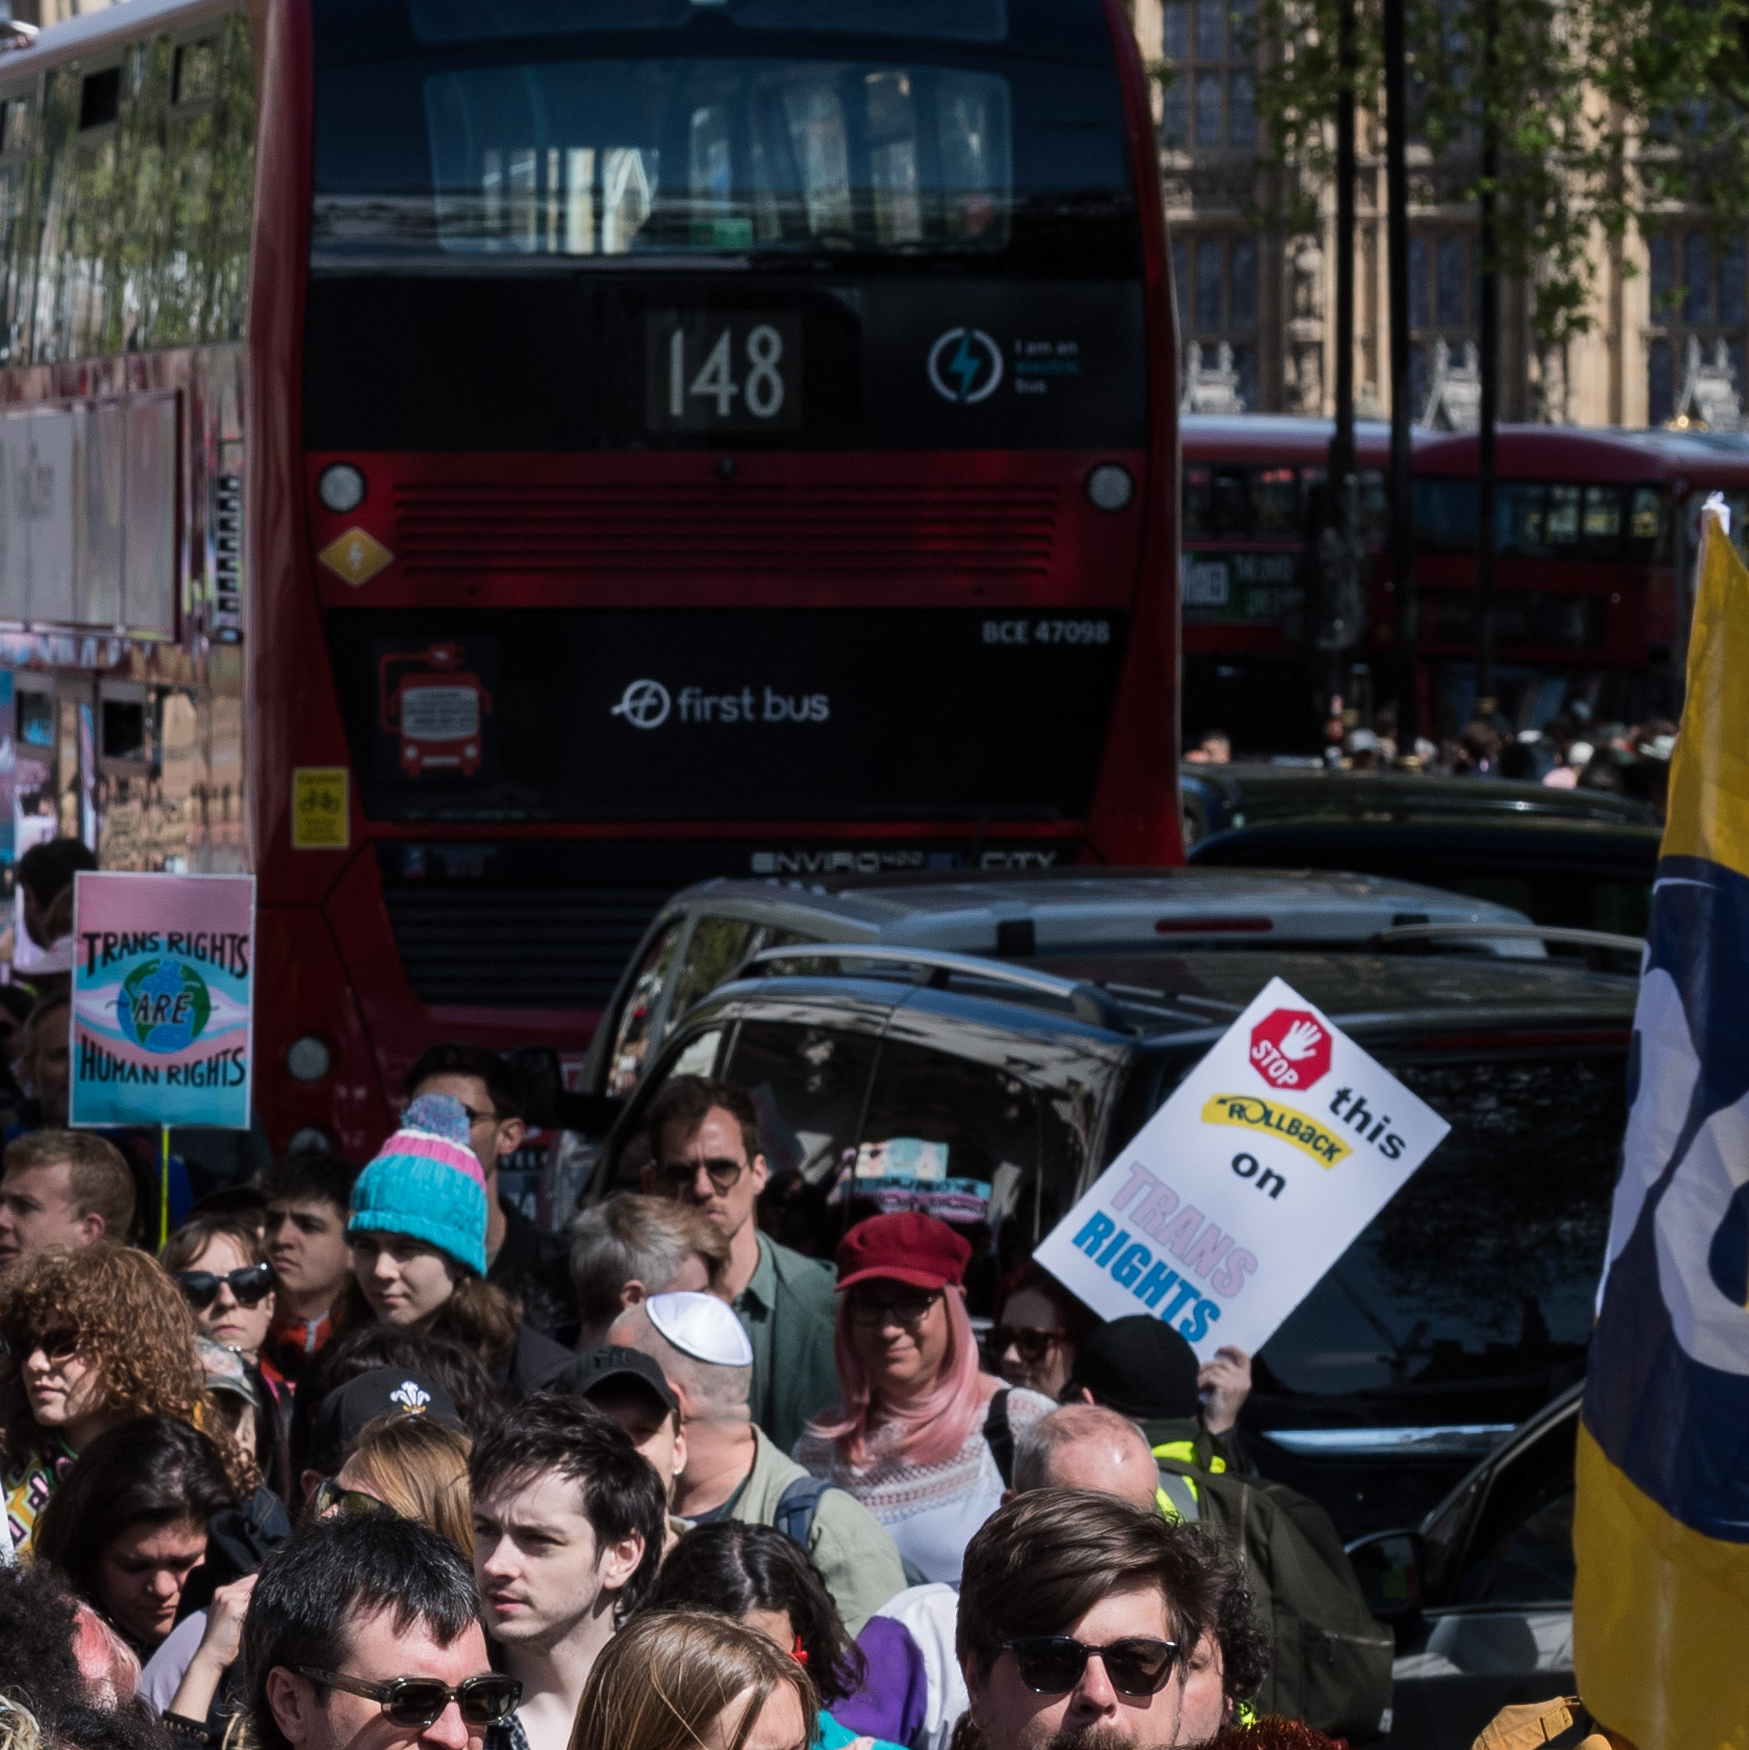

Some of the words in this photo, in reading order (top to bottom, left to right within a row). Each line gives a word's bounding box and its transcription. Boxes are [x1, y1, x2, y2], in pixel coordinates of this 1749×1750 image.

[668, 324, 786, 419] 148
[677, 684, 756, 722] first
[763, 684, 831, 722] bus
[81, 931, 161, 978] TRANS
[166, 931, 249, 980] RIGHTS
[132, 992, 194, 1026] ARE
[80, 1034, 161, 1087] HUMAN
[166, 1046, 247, 1088] RIGHTS
[1251, 1038, 1301, 1089] STOP
[1327, 1086, 1408, 1161] this
[1230, 1151, 1288, 1200] on
[1109, 1160, 1260, 1299] TRANS
[1070, 1209, 1223, 1344] RIGHTS
